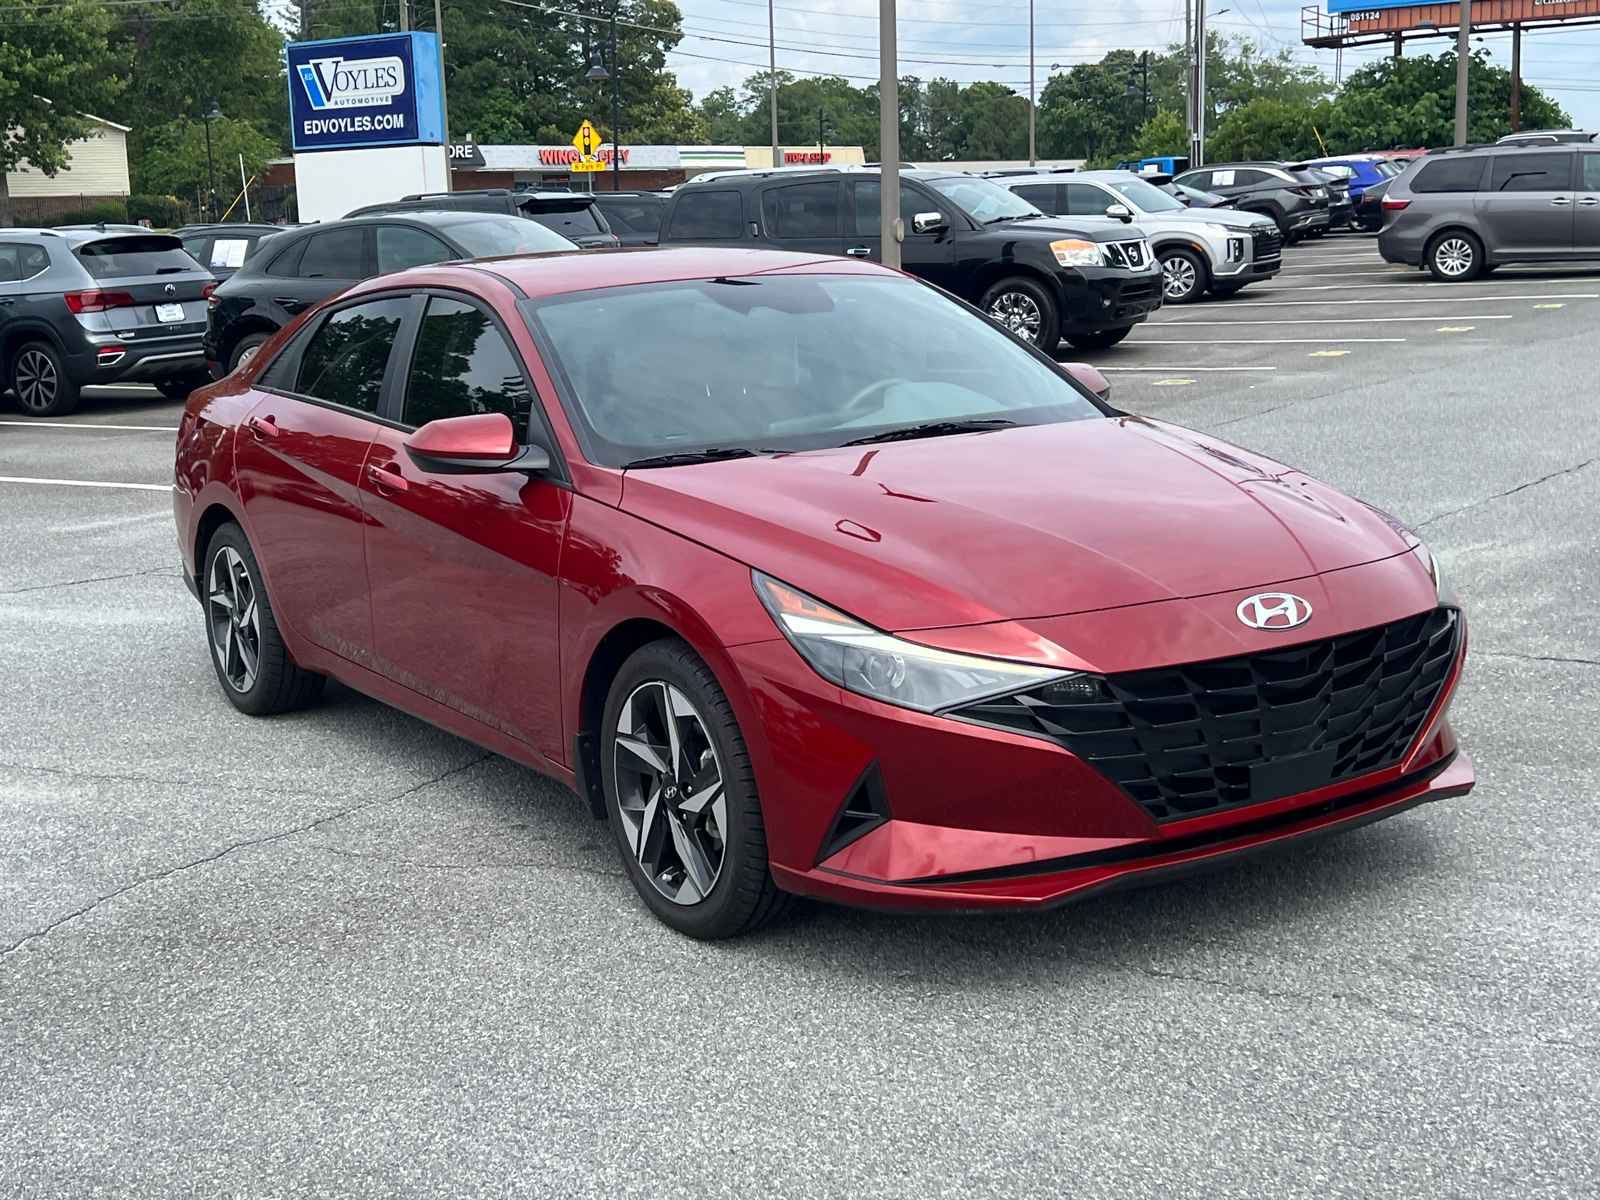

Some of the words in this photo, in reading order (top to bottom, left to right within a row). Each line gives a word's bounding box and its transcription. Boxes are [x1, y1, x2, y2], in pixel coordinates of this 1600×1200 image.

[304, 73, 313, 81] ED
[312, 60, 397, 102] VOYLES
[334, 96, 390, 106] AUTOMOTIVE
[304, 114, 404, 135] EDVOYLES.COM
[539, 149, 580, 164] WING
